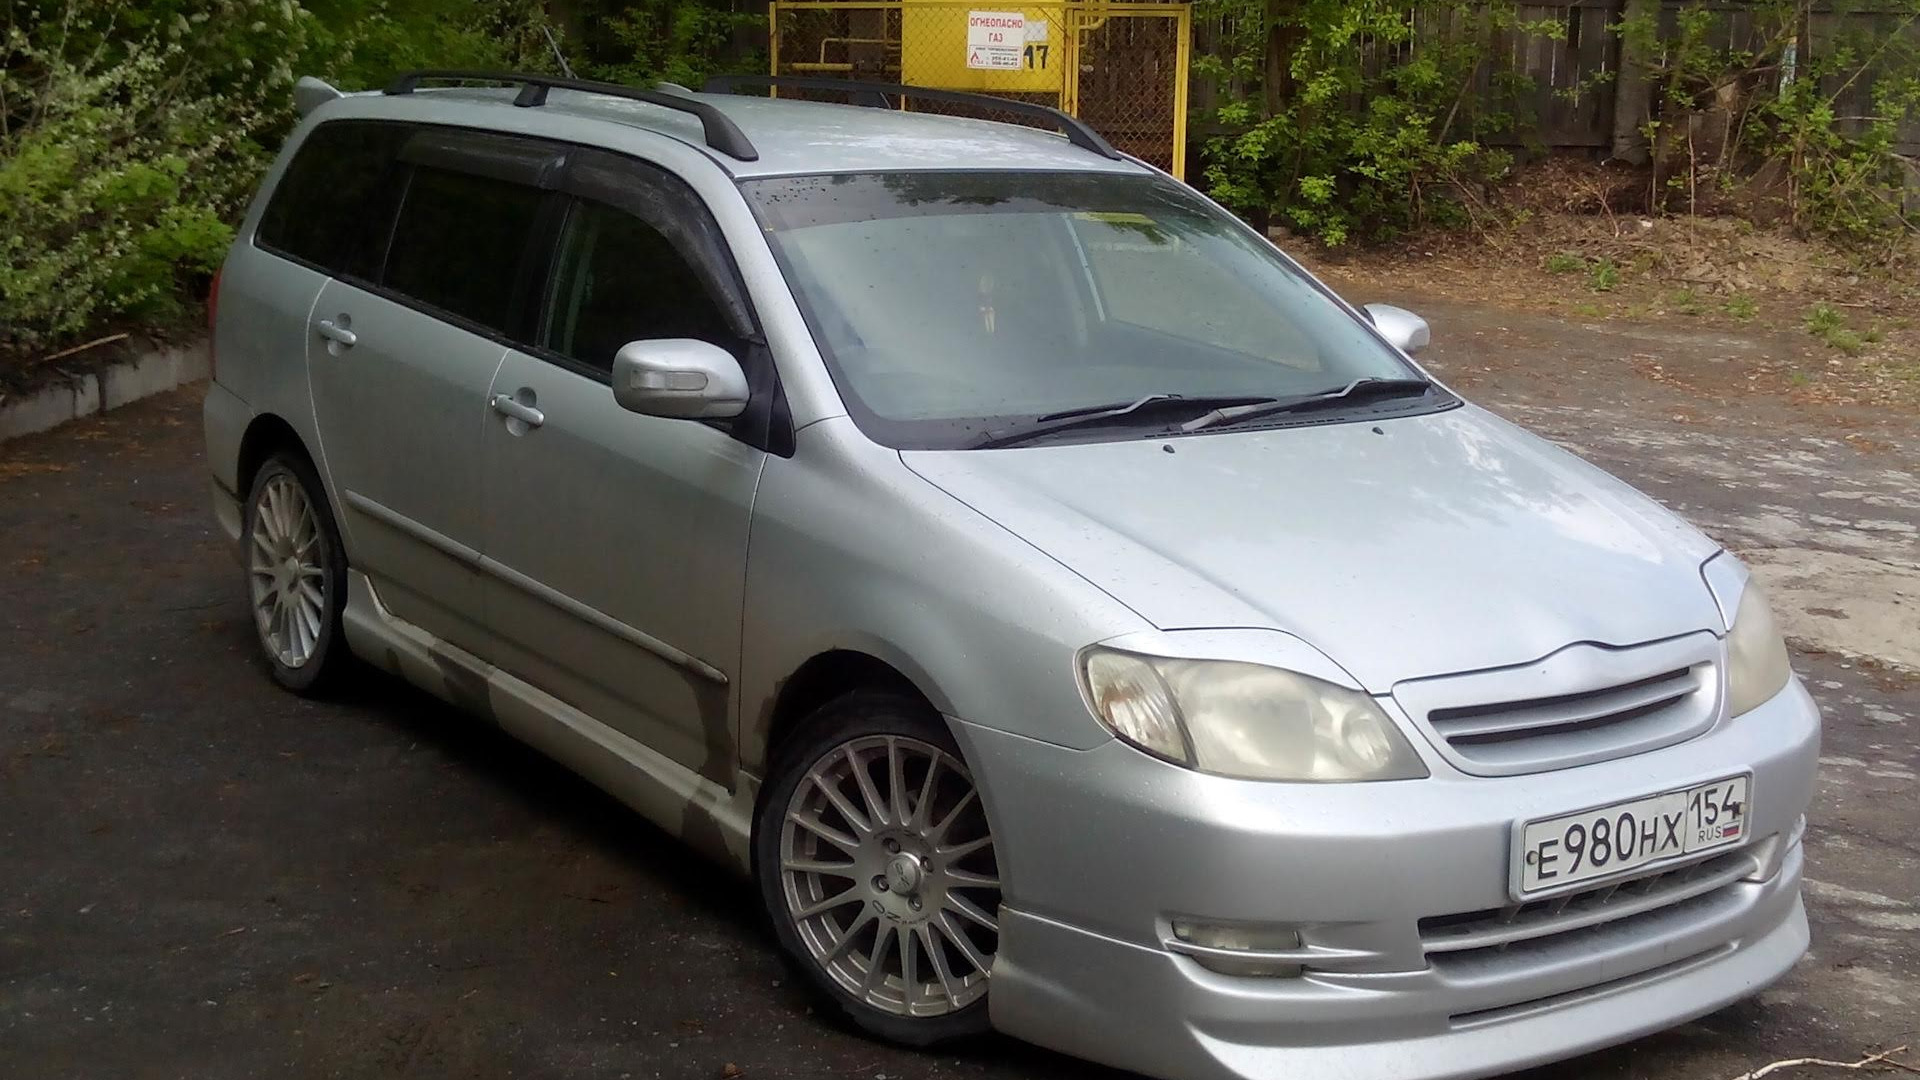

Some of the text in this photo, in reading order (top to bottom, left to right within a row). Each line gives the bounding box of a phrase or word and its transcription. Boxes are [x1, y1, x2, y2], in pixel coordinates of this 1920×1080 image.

[970, 17, 1023, 28] ОГНЕОПАСНО
[988, 33, 1003, 43] ГАЗ
[1023, 45, 1049, 69] 17
[1690, 784, 1740, 830] 154
[1698, 827, 1722, 844] RUS
